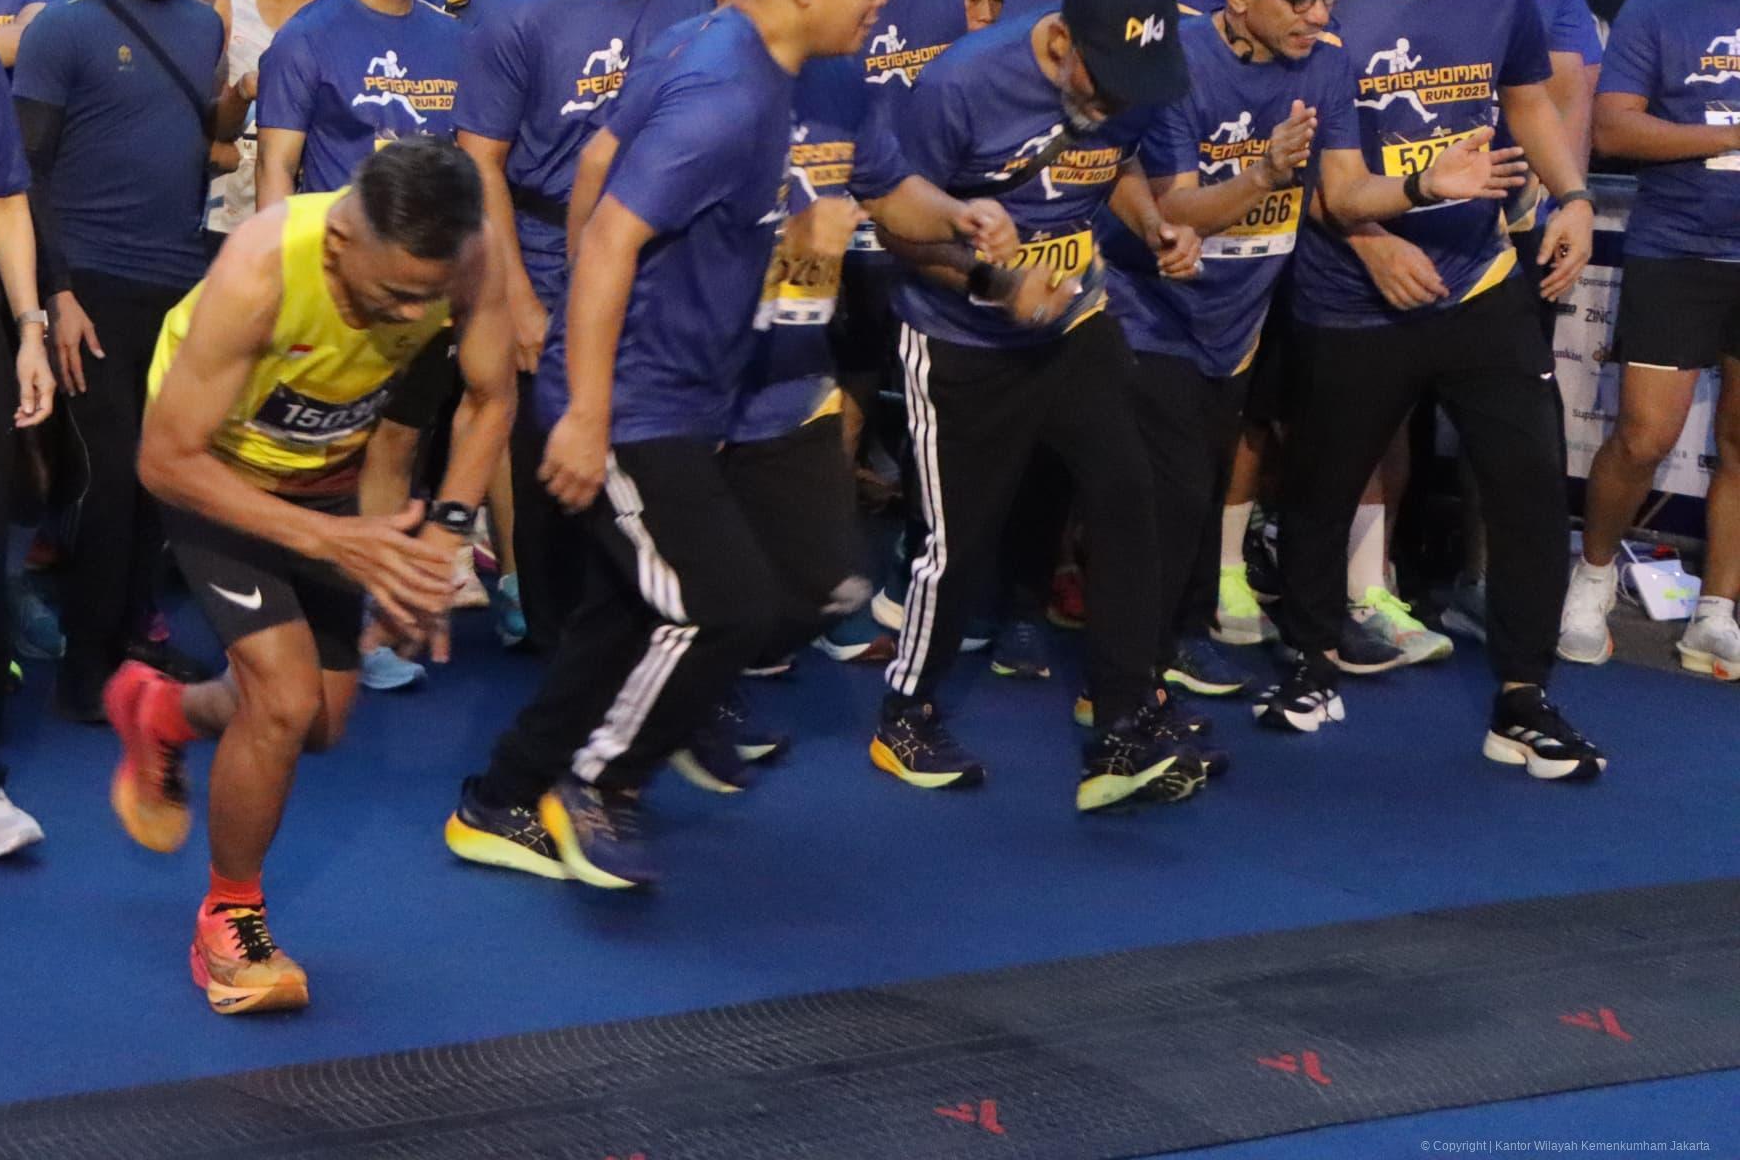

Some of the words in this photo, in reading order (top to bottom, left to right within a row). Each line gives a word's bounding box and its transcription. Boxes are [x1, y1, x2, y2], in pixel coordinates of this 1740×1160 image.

[1359, 63, 1493, 94] PENGAYOMAN
[1425, 90, 1453, 101] RUN
[1456, 86, 1487, 97] 2025
[1055, 171, 1085, 181] RUN
[1015, 239, 1079, 270] 2700
[1585, 308, 1613, 326] ZINC
